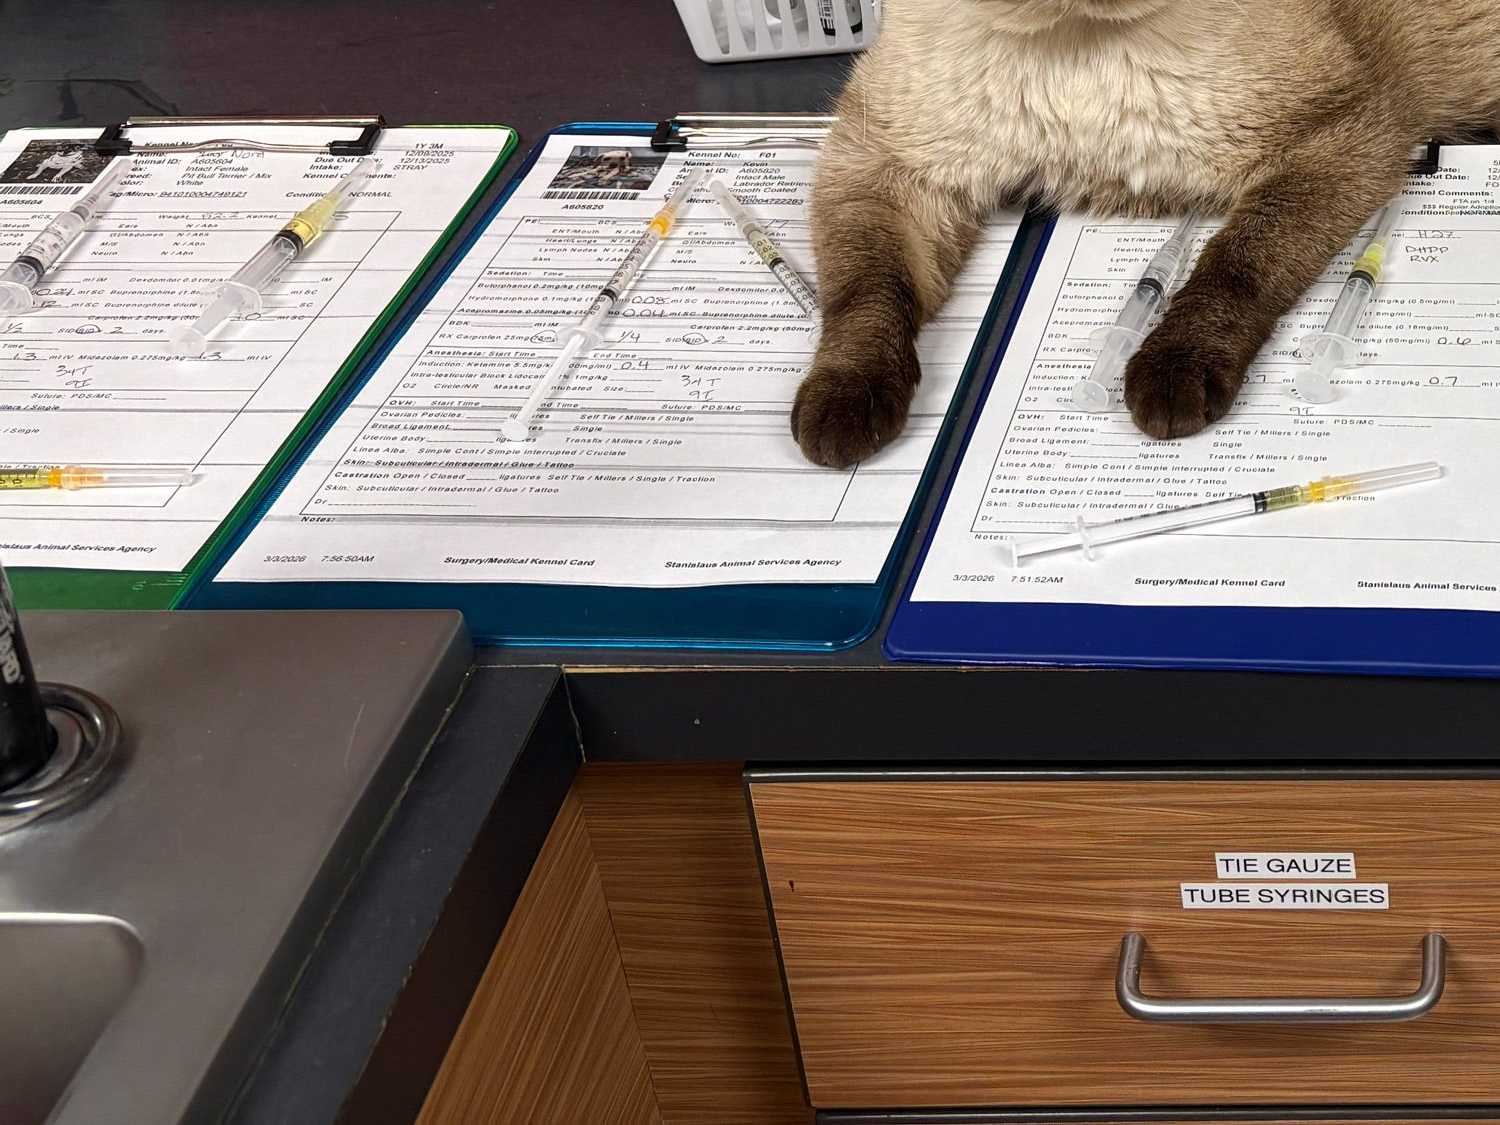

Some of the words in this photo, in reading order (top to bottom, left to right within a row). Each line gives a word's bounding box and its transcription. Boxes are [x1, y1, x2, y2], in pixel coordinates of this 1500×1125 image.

[444, 557, 529, 565] Surgery/Medical
[1135, 578, 1218, 586] Surgery/Medical
[1219, 859, 1258, 872] TIE
[1267, 859, 1351, 872] GAUZE
[1184, 889, 1250, 902] TUBE
[1258, 889, 1384, 903] SYRINGES
